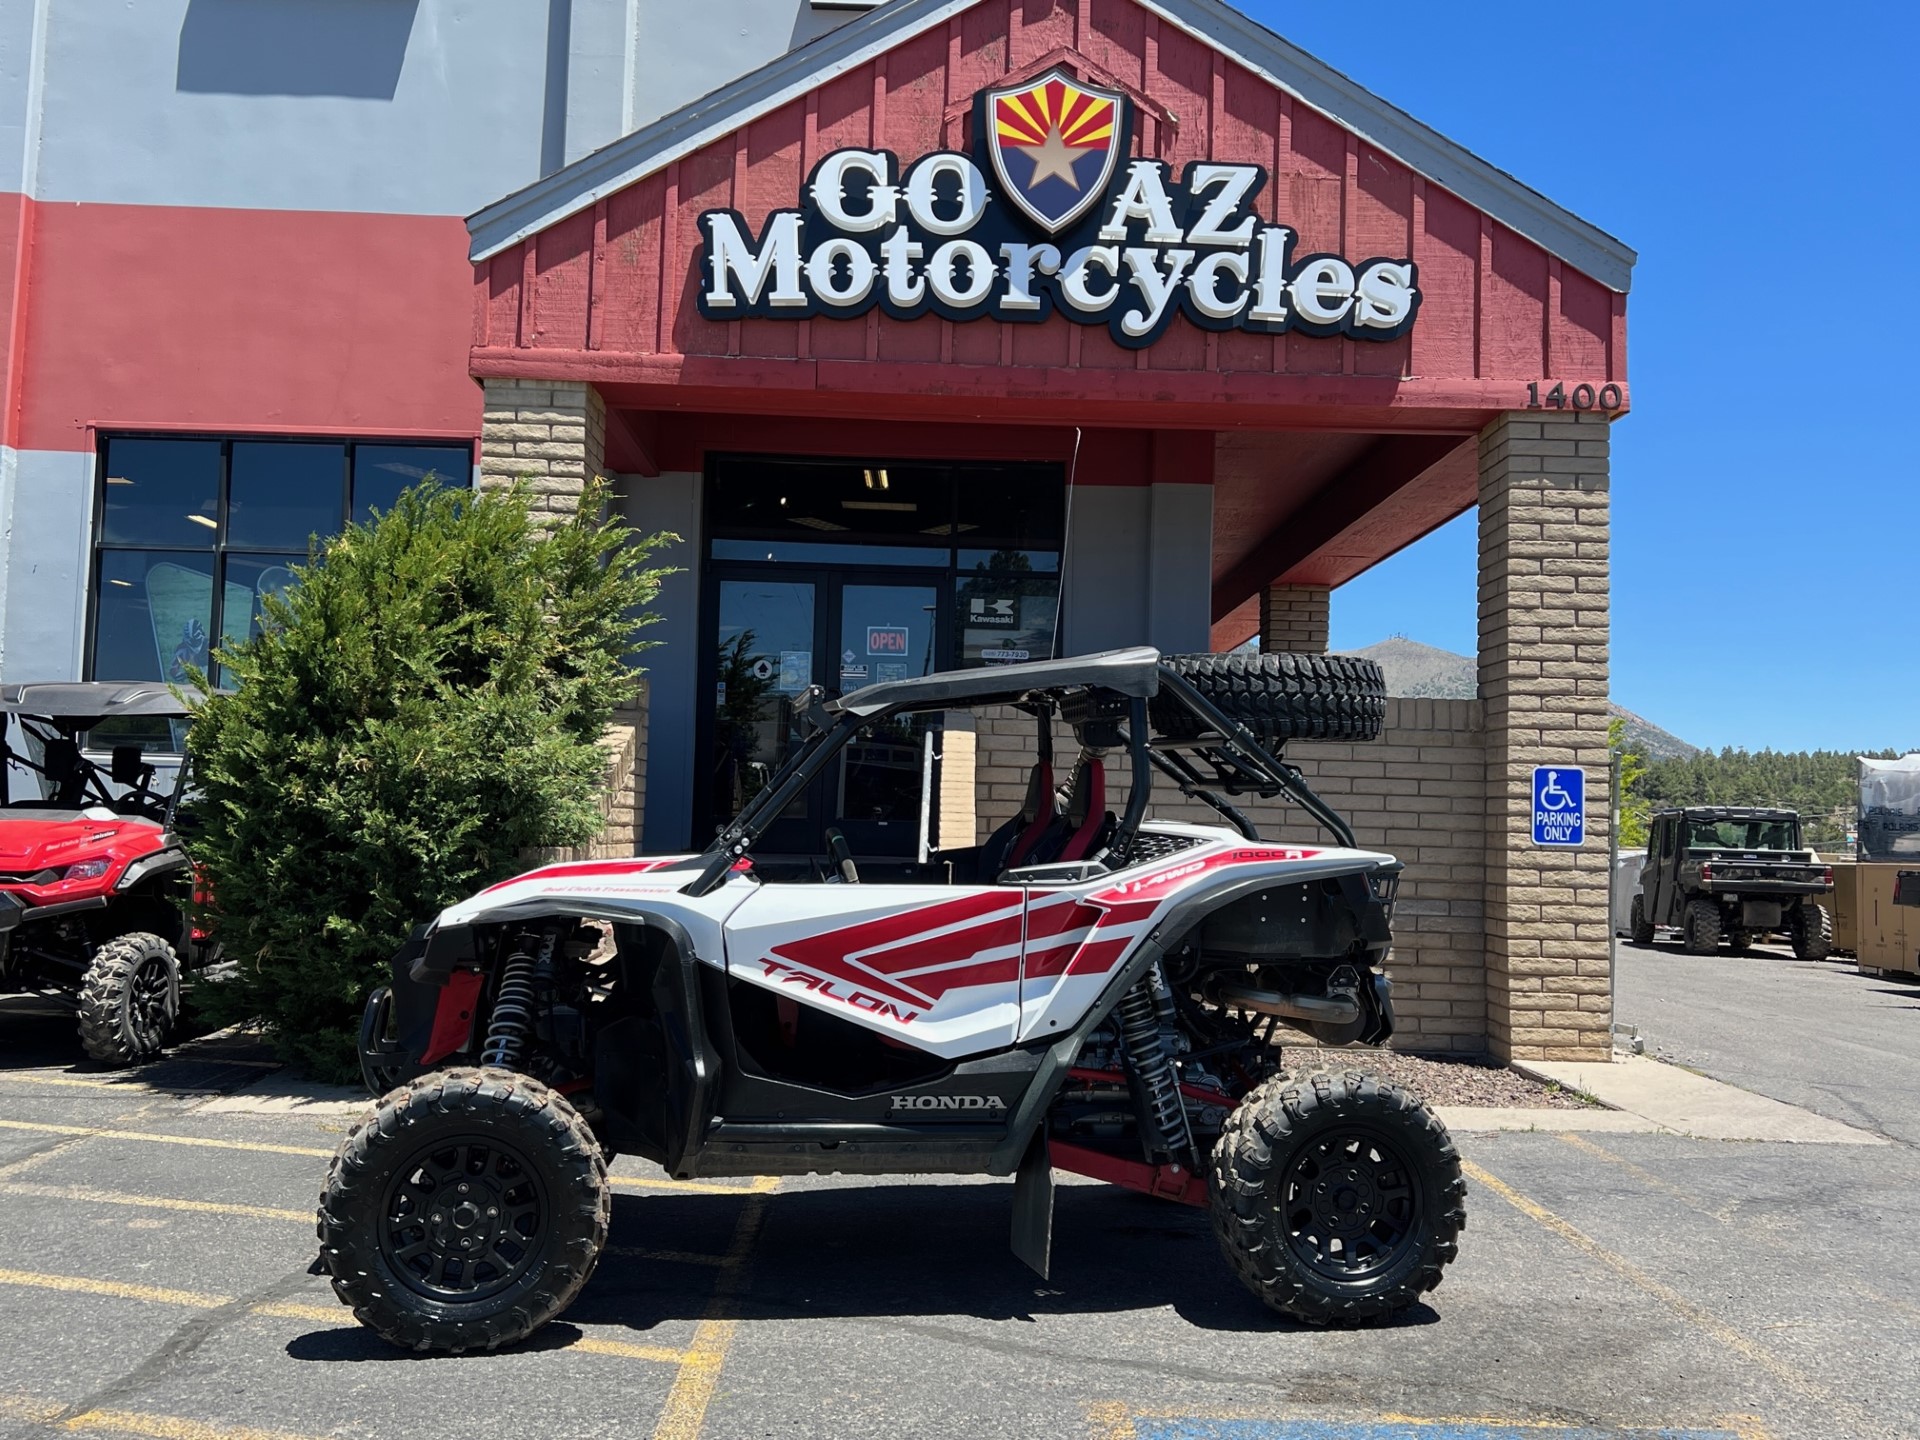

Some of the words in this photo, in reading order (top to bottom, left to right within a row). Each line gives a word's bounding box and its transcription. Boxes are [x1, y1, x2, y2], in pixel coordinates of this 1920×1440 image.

[808, 148, 992, 235] GO
[1099, 160, 1260, 246] AZ
[705, 212, 1416, 337] Motorcycles
[1526, 381, 1623, 410] 1400
[969, 614, 1014, 624] Kawasaki
[870, 632, 905, 650] OPEN
[1536, 811, 1581, 827] PARKING
[1544, 826, 1573, 841] ONLY
[1232, 850, 1303, 860] 1000R
[538, 933, 557, 964] FOX
[757, 957, 920, 1025] TALON
[890, 1095, 1007, 1110] HONDA
